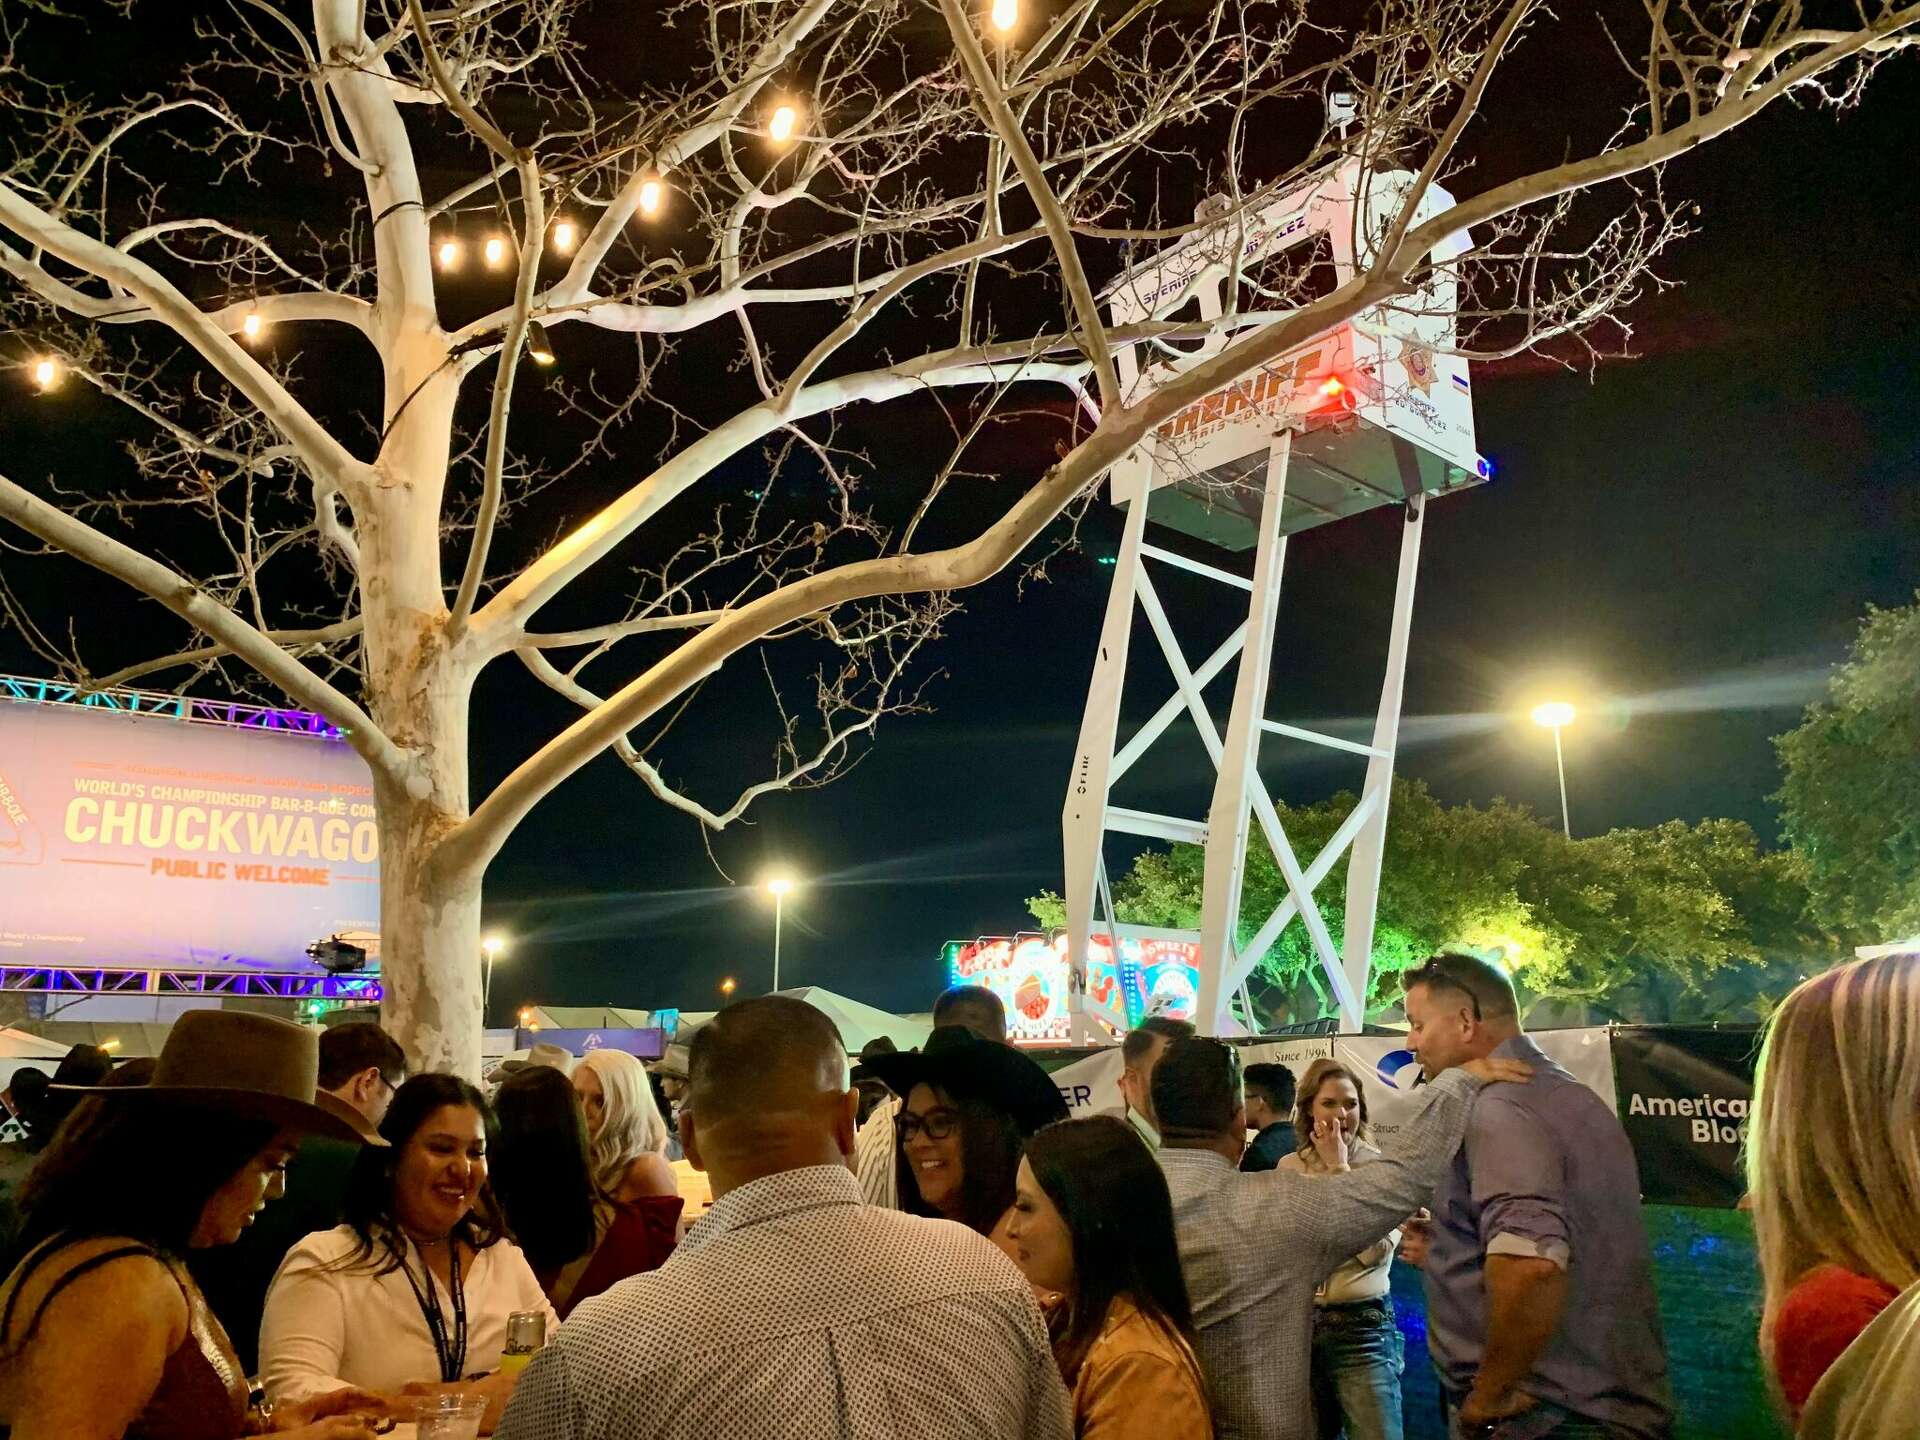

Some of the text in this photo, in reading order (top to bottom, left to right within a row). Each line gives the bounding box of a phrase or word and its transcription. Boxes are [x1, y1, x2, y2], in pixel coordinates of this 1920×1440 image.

[1143, 270, 1197, 305] SHERIFF
[74, 778, 145, 798] WORLD'S
[151, 785, 266, 808] CHAMPIONSHIP
[271, 796, 346, 816] BAR-B-QUE
[151, 858, 330, 886] PUBLIC WELCOME
[1274, 1051, 1301, 1063] Since
